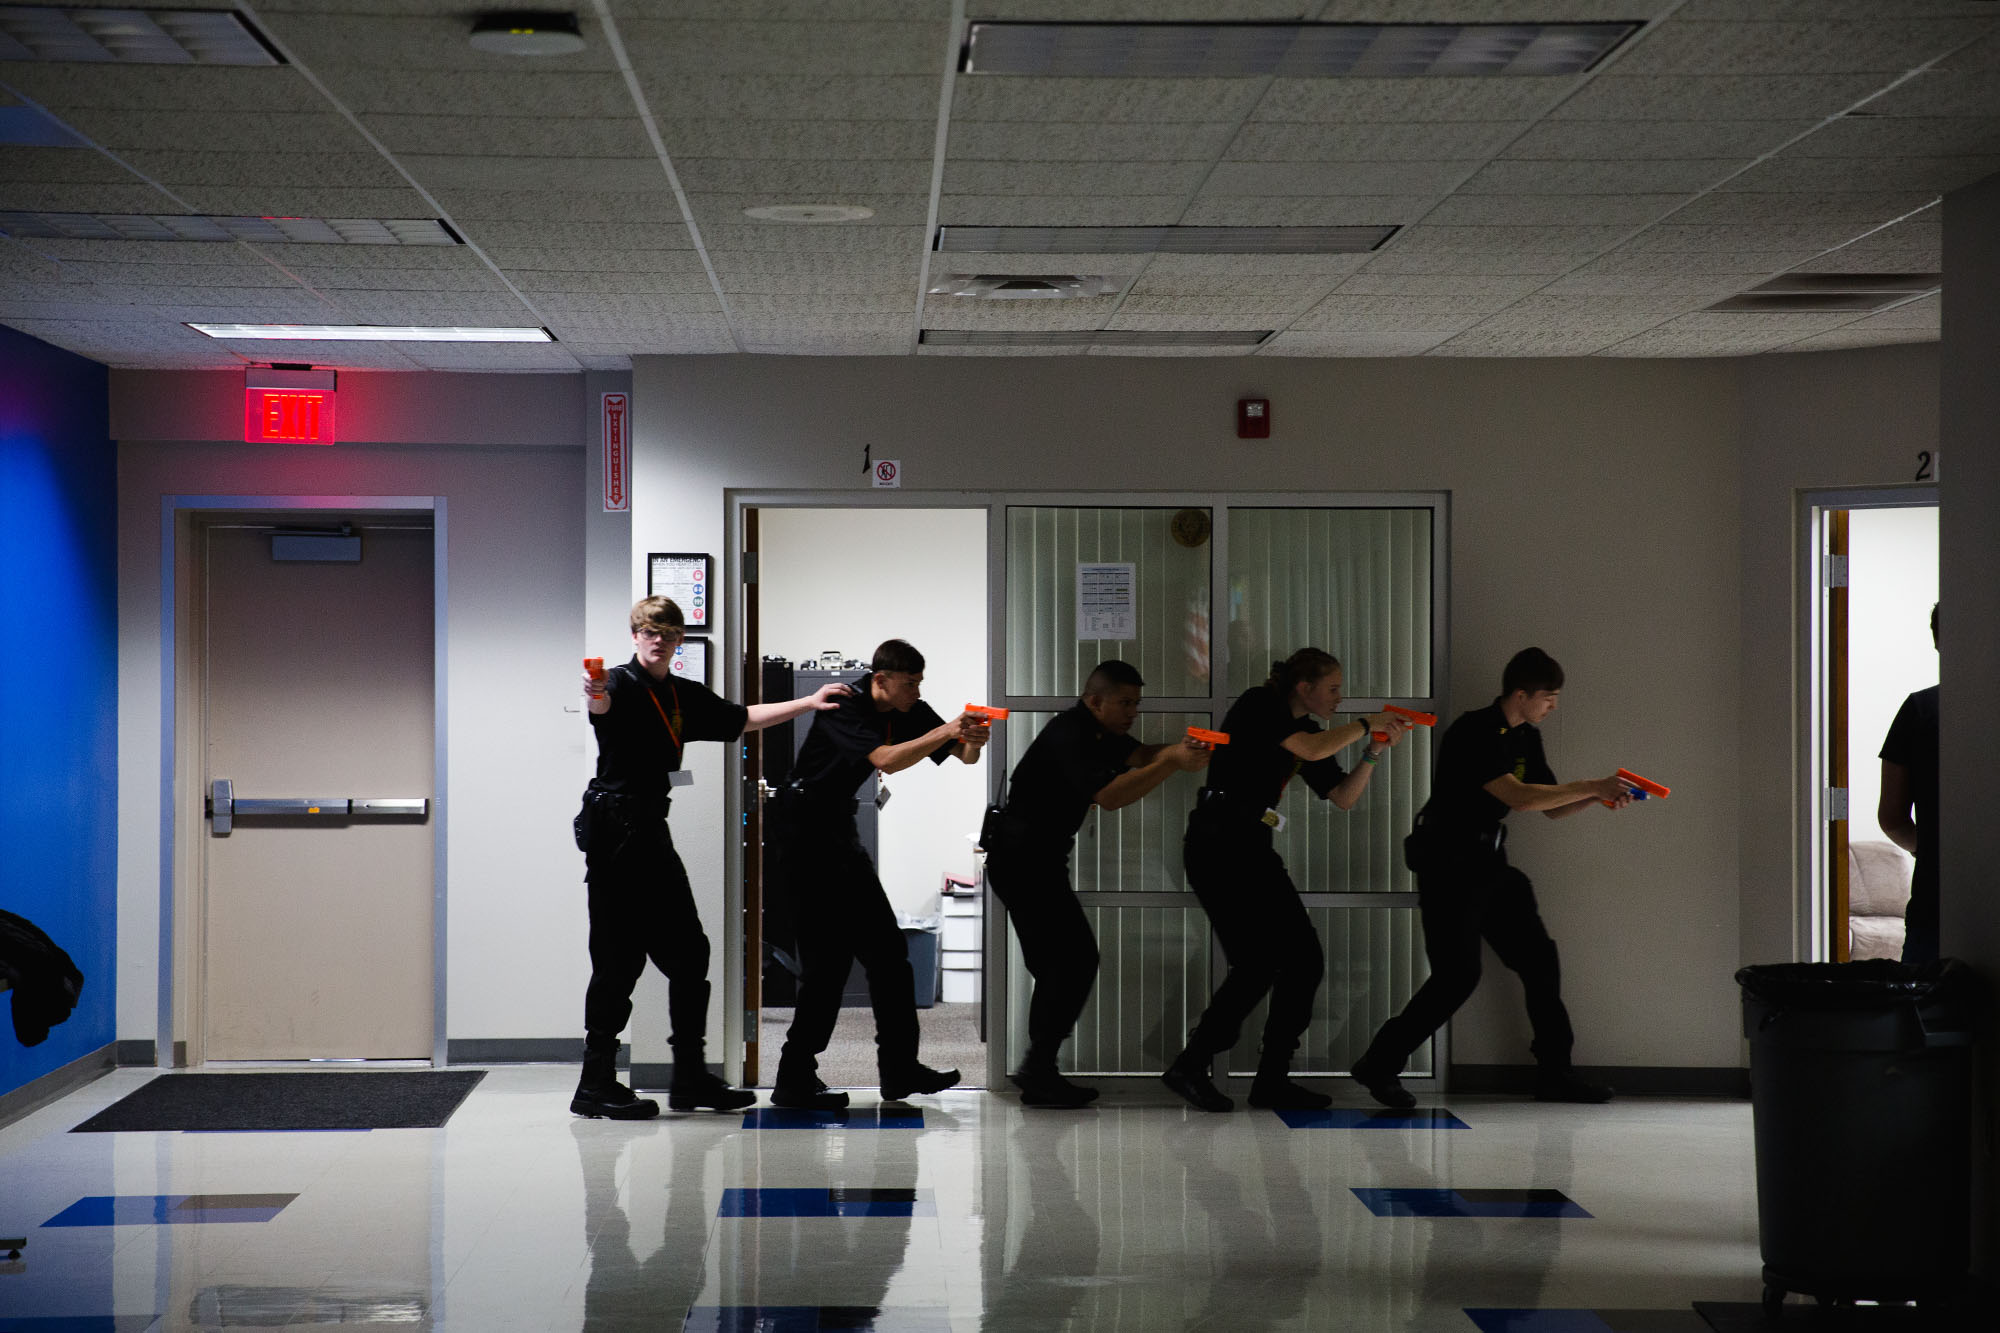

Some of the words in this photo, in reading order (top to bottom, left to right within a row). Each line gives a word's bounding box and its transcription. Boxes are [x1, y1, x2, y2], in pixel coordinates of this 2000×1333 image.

[263, 394, 323, 439] EXIT
[612, 413, 620, 501] EXTINGUISHER
[862, 444, 871, 474] 1
[1915, 451, 1930, 481] 2
